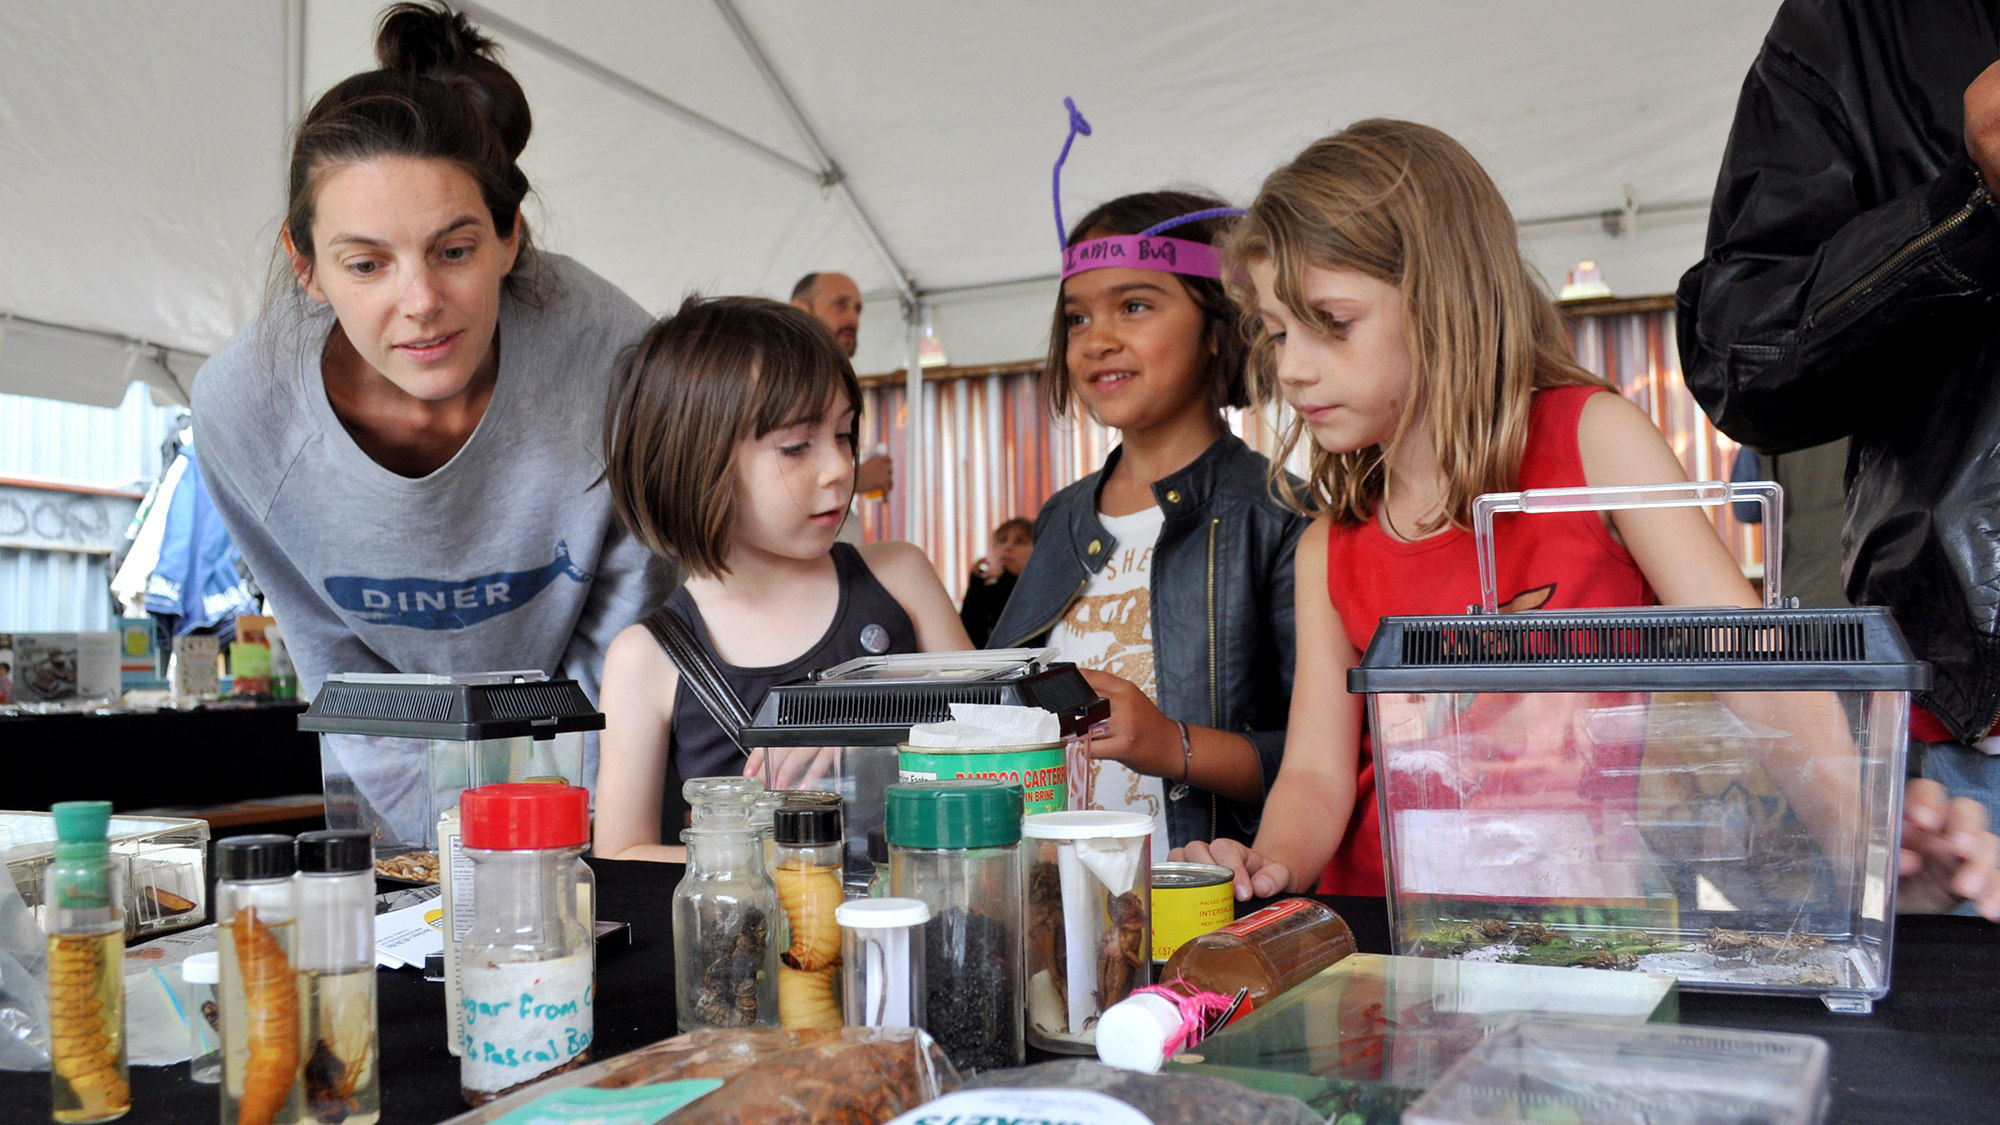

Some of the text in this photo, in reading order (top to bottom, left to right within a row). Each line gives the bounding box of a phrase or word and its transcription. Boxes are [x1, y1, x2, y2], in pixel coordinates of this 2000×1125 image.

[1065, 244, 1077, 270] I
[361, 582, 512, 612] DINER
[1025, 788, 1054, 802] IN BRINE
[483, 1039, 560, 1067] Pascal
